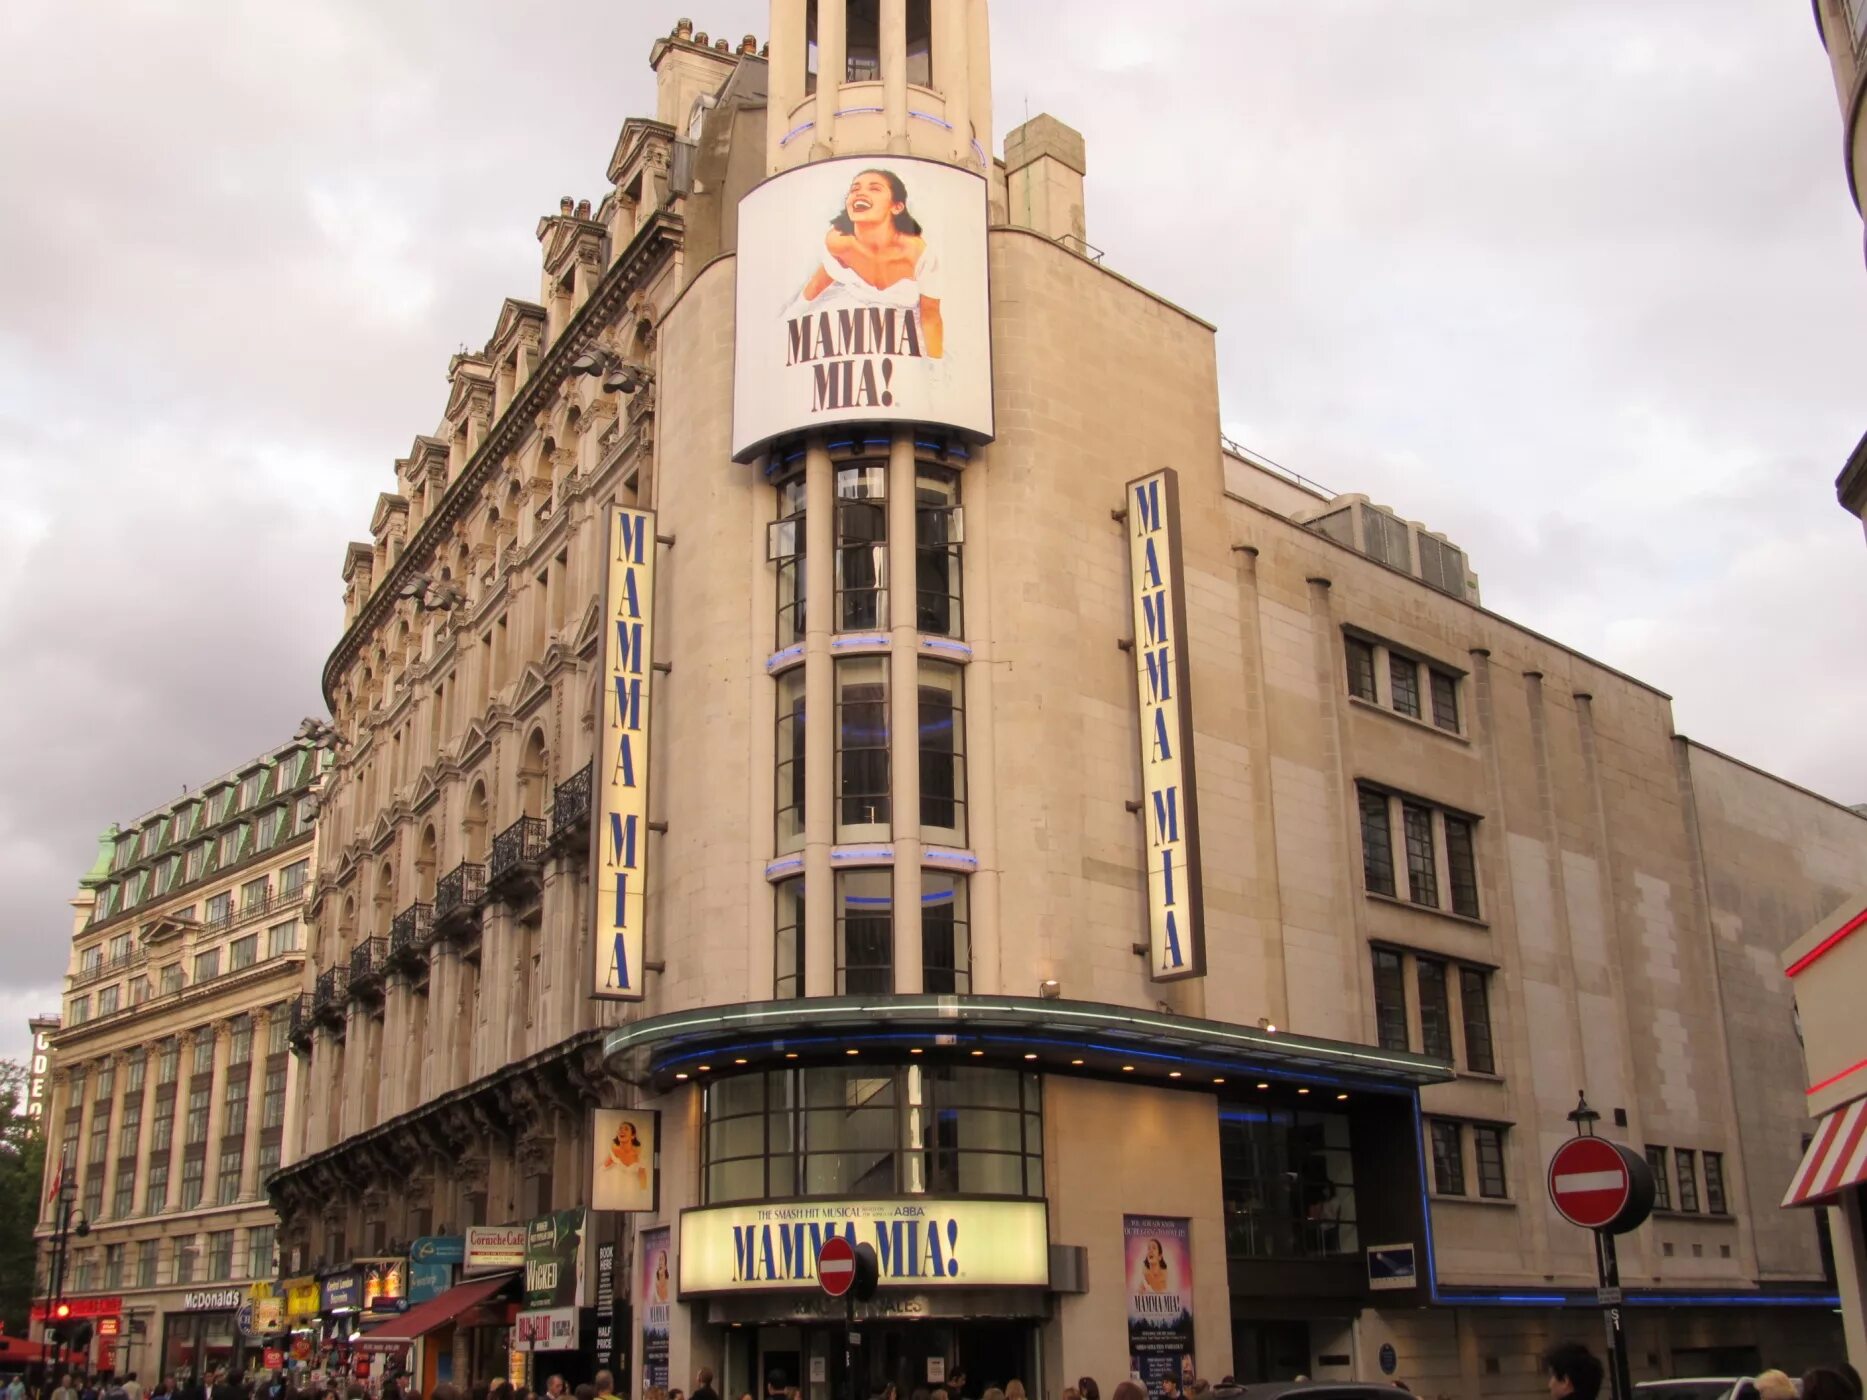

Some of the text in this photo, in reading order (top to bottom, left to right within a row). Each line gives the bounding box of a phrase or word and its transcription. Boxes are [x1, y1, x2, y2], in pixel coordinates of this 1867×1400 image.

[786, 307, 922, 367] MAMMA
[811, 358, 894, 412] MIA!
[605, 512, 647, 990] MAMMA MIA
[1134, 480, 1184, 970] MAMMA MIA
[470, 1230, 505, 1246] Corniche
[758, 1207, 862, 1220] THE SMASH HIT MUSICAL
[894, 1206, 925, 1217] ABBA
[874, 1219, 959, 1278] MIA!
[185, 1289, 240, 1309] McDonald's
